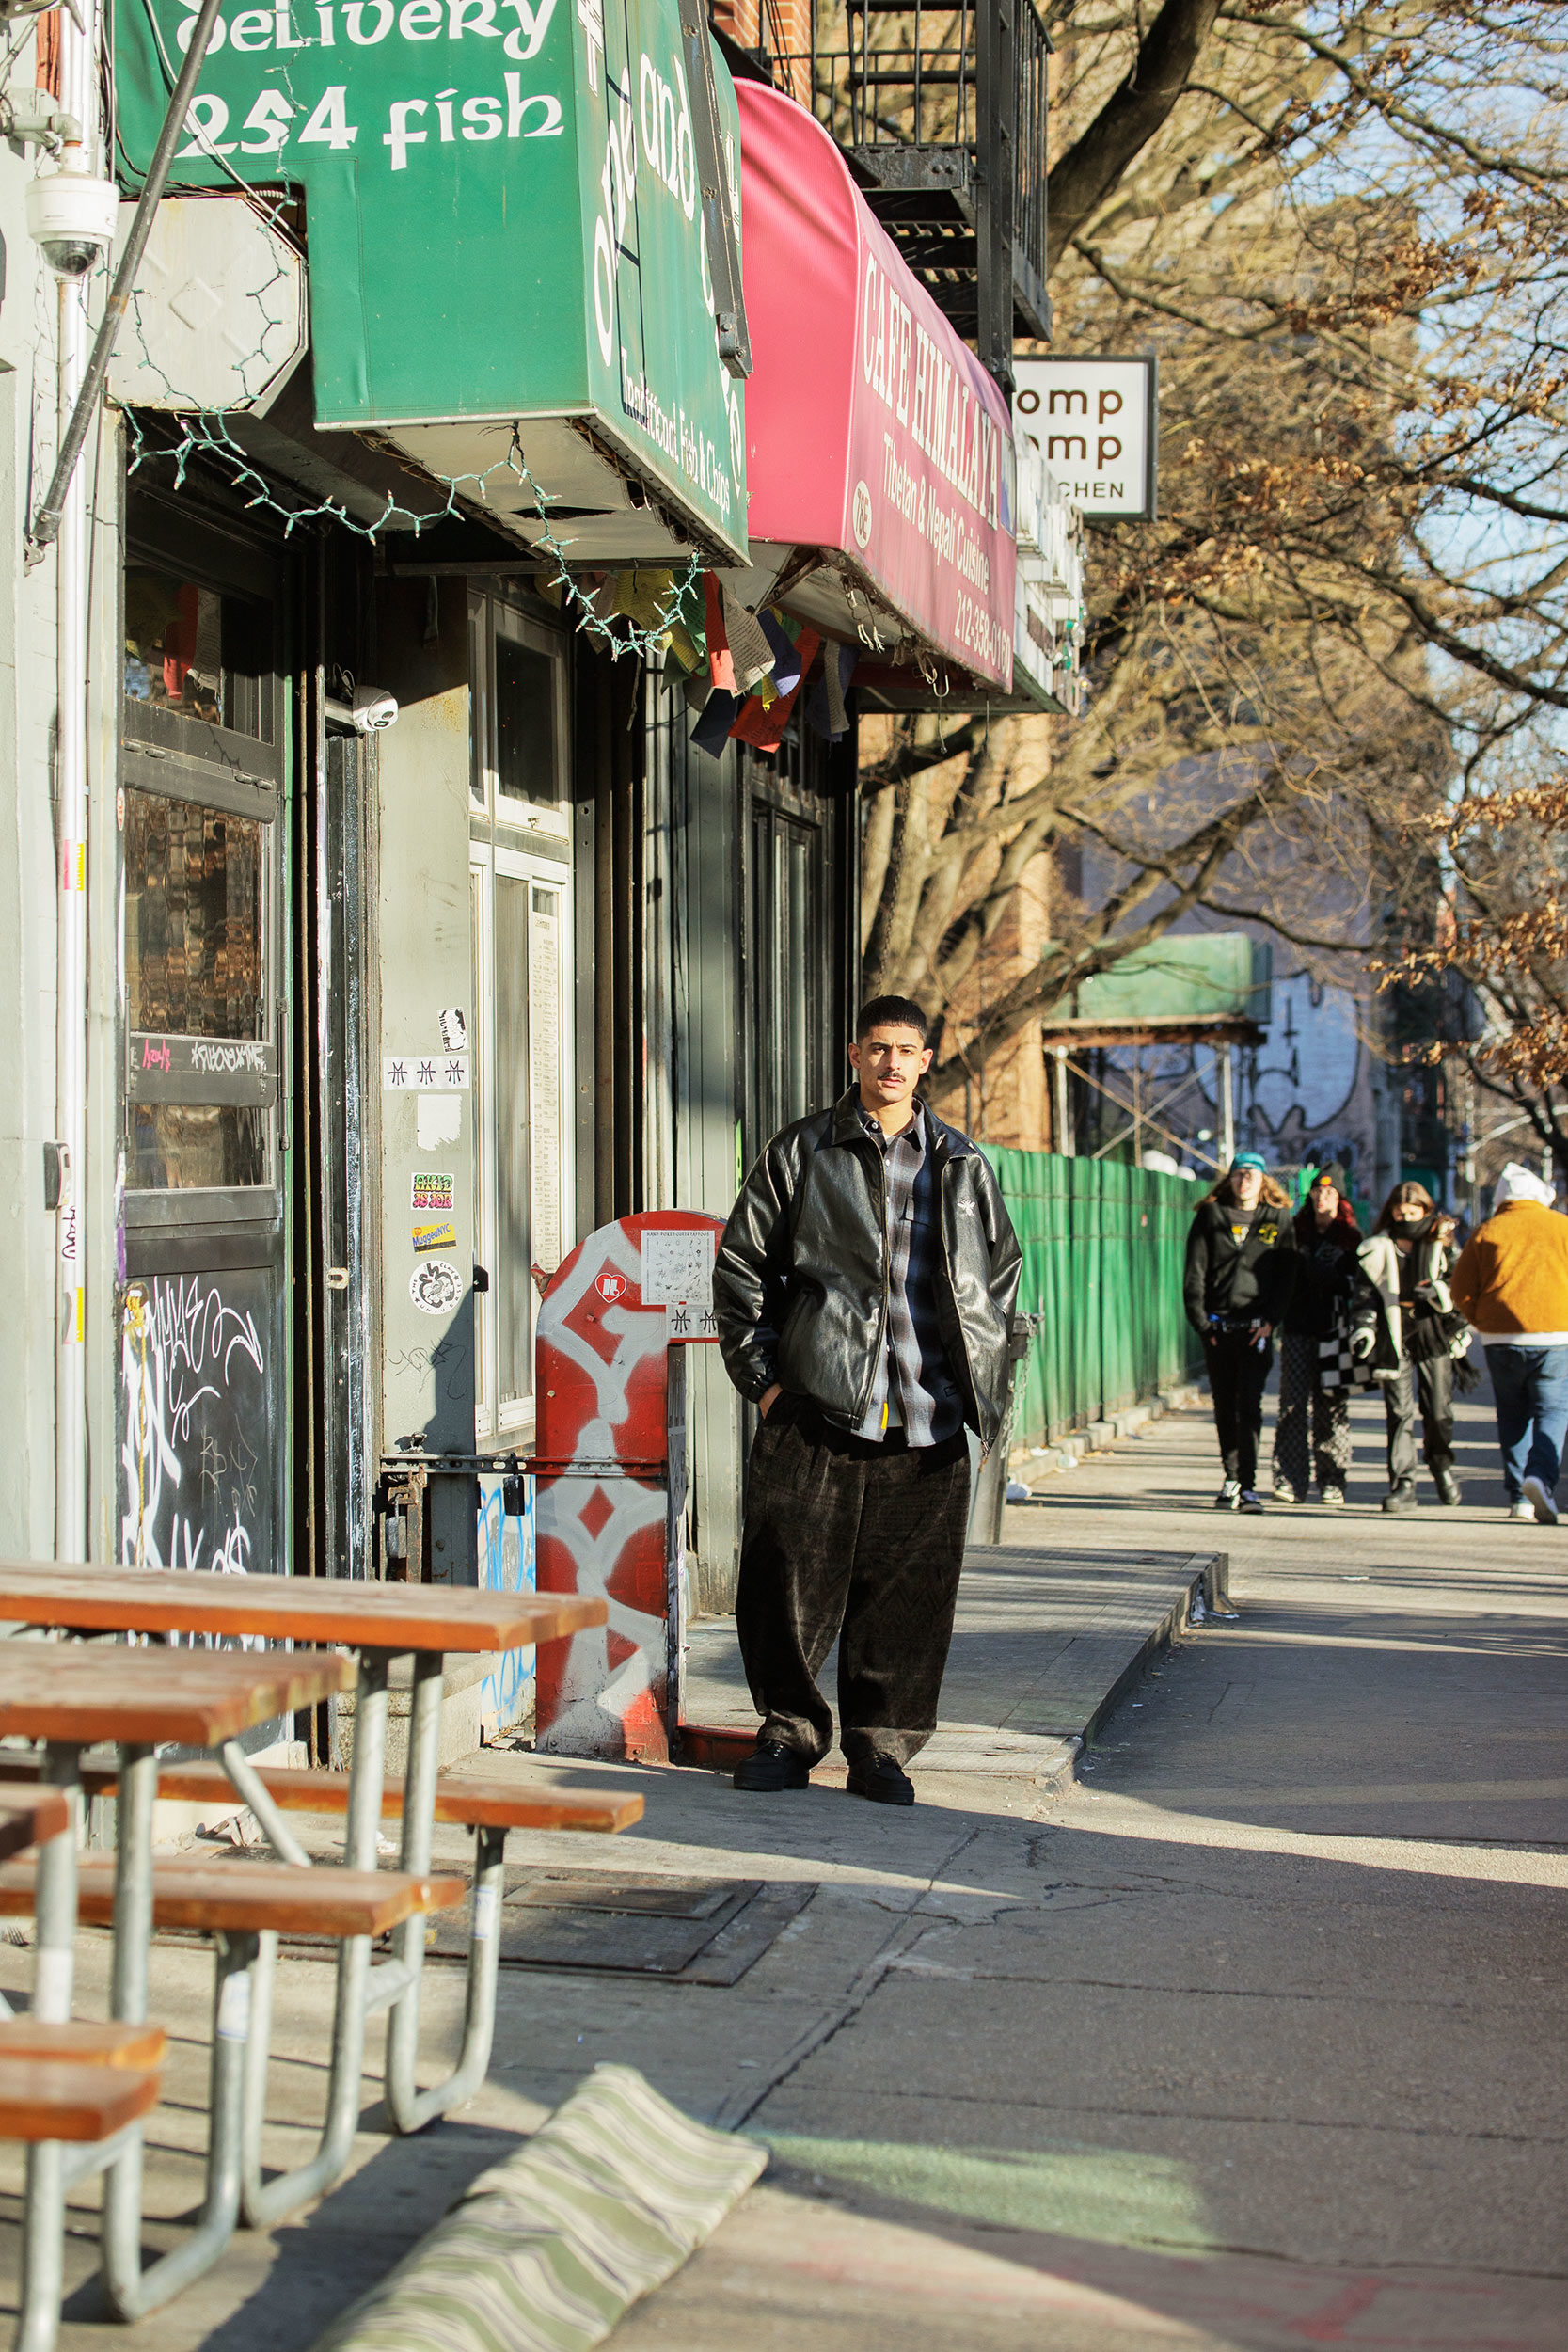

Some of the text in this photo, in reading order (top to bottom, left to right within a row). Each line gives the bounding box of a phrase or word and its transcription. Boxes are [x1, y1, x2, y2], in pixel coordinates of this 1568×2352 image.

[173, 72, 564, 170] 254 fish
[641, 53, 695, 221] and
[863, 251, 998, 532] CAFE HIMALAYA
[1028, 435, 1122, 470] mp
[883, 429, 990, 595] Tibetan & Nepali Cuisine
[954, 588, 1012, 679] 212-358-0160
